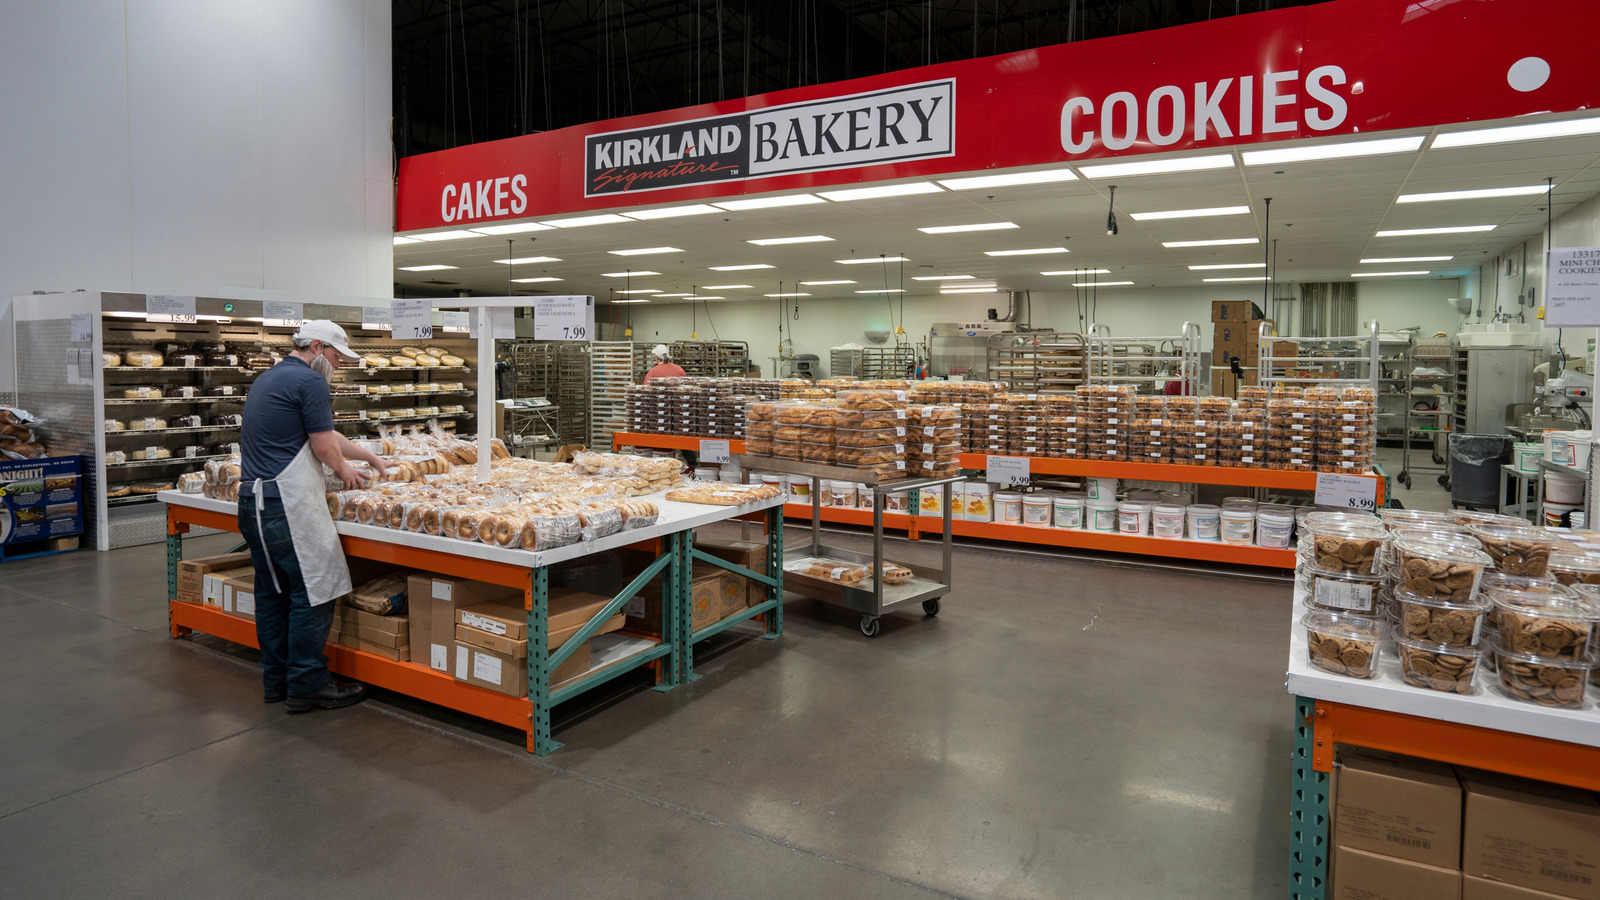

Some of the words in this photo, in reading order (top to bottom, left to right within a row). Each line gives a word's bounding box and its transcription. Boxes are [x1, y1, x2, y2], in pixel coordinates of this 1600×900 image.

[1060, 65, 1348, 154] COOKIES
[753, 96, 943, 164] BAKERY
[594, 124, 742, 170] KIRKLAND
[593, 160, 740, 192] Signature
[441, 173, 528, 223] CAKES
[1558, 267, 1600, 275] COOKIES
[170, 314, 195, 322] 15.99
[282, 318, 302, 326] 15.99
[414, 327, 431, 338] 7.99
[563, 327, 585, 339] 7.99
[1011, 475, 1029, 485] 9.99
[1348, 497, 1374, 508] 8.99
